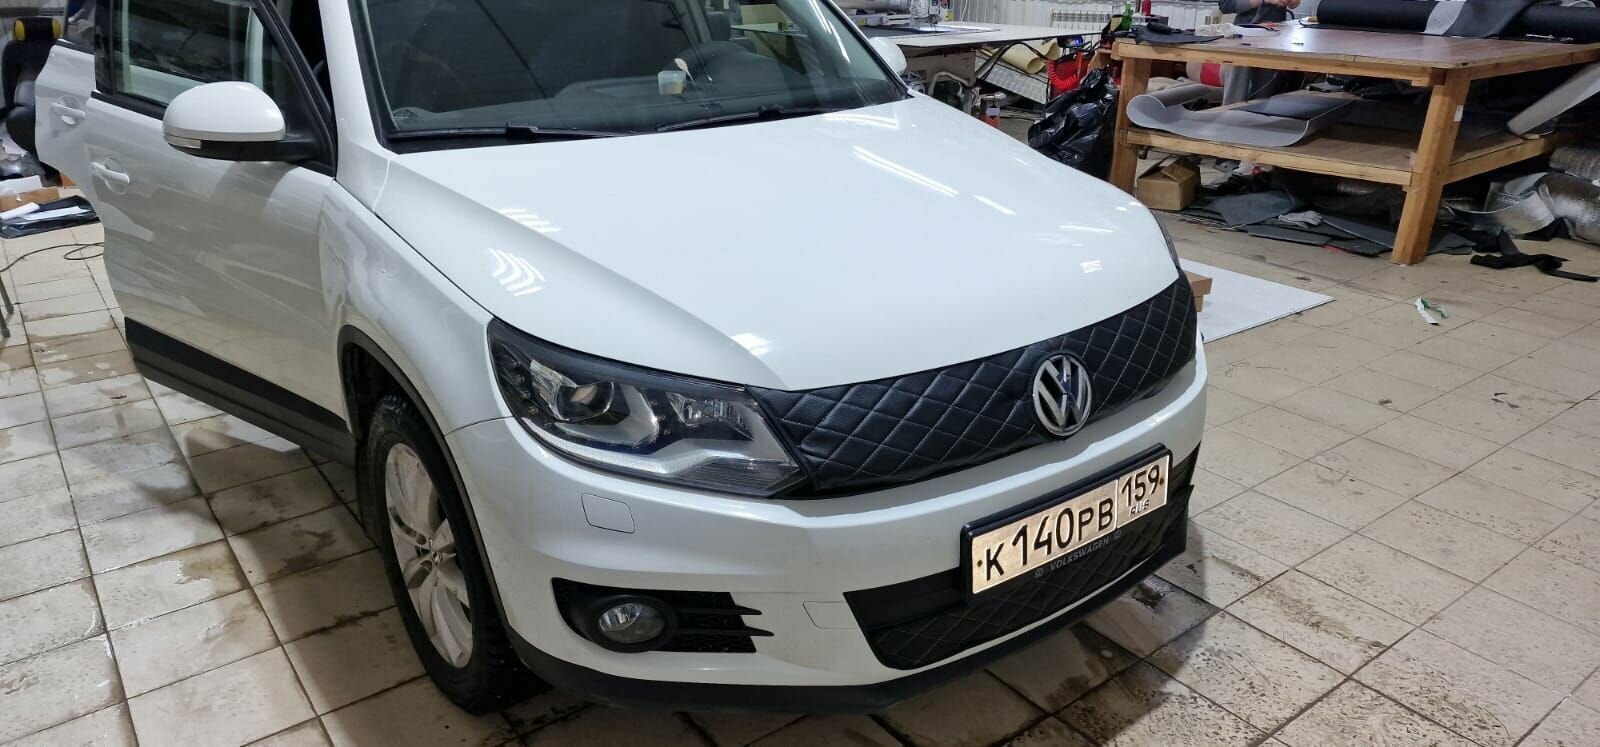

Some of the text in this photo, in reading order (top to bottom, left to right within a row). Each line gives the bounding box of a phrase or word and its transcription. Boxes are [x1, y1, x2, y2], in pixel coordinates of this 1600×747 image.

[1033, 355, 1092, 436] VW
[1120, 465, 1160, 507] 159
[1129, 499, 1150, 518] RUS
[1050, 537, 1110, 571] VOLKSWAGEN
